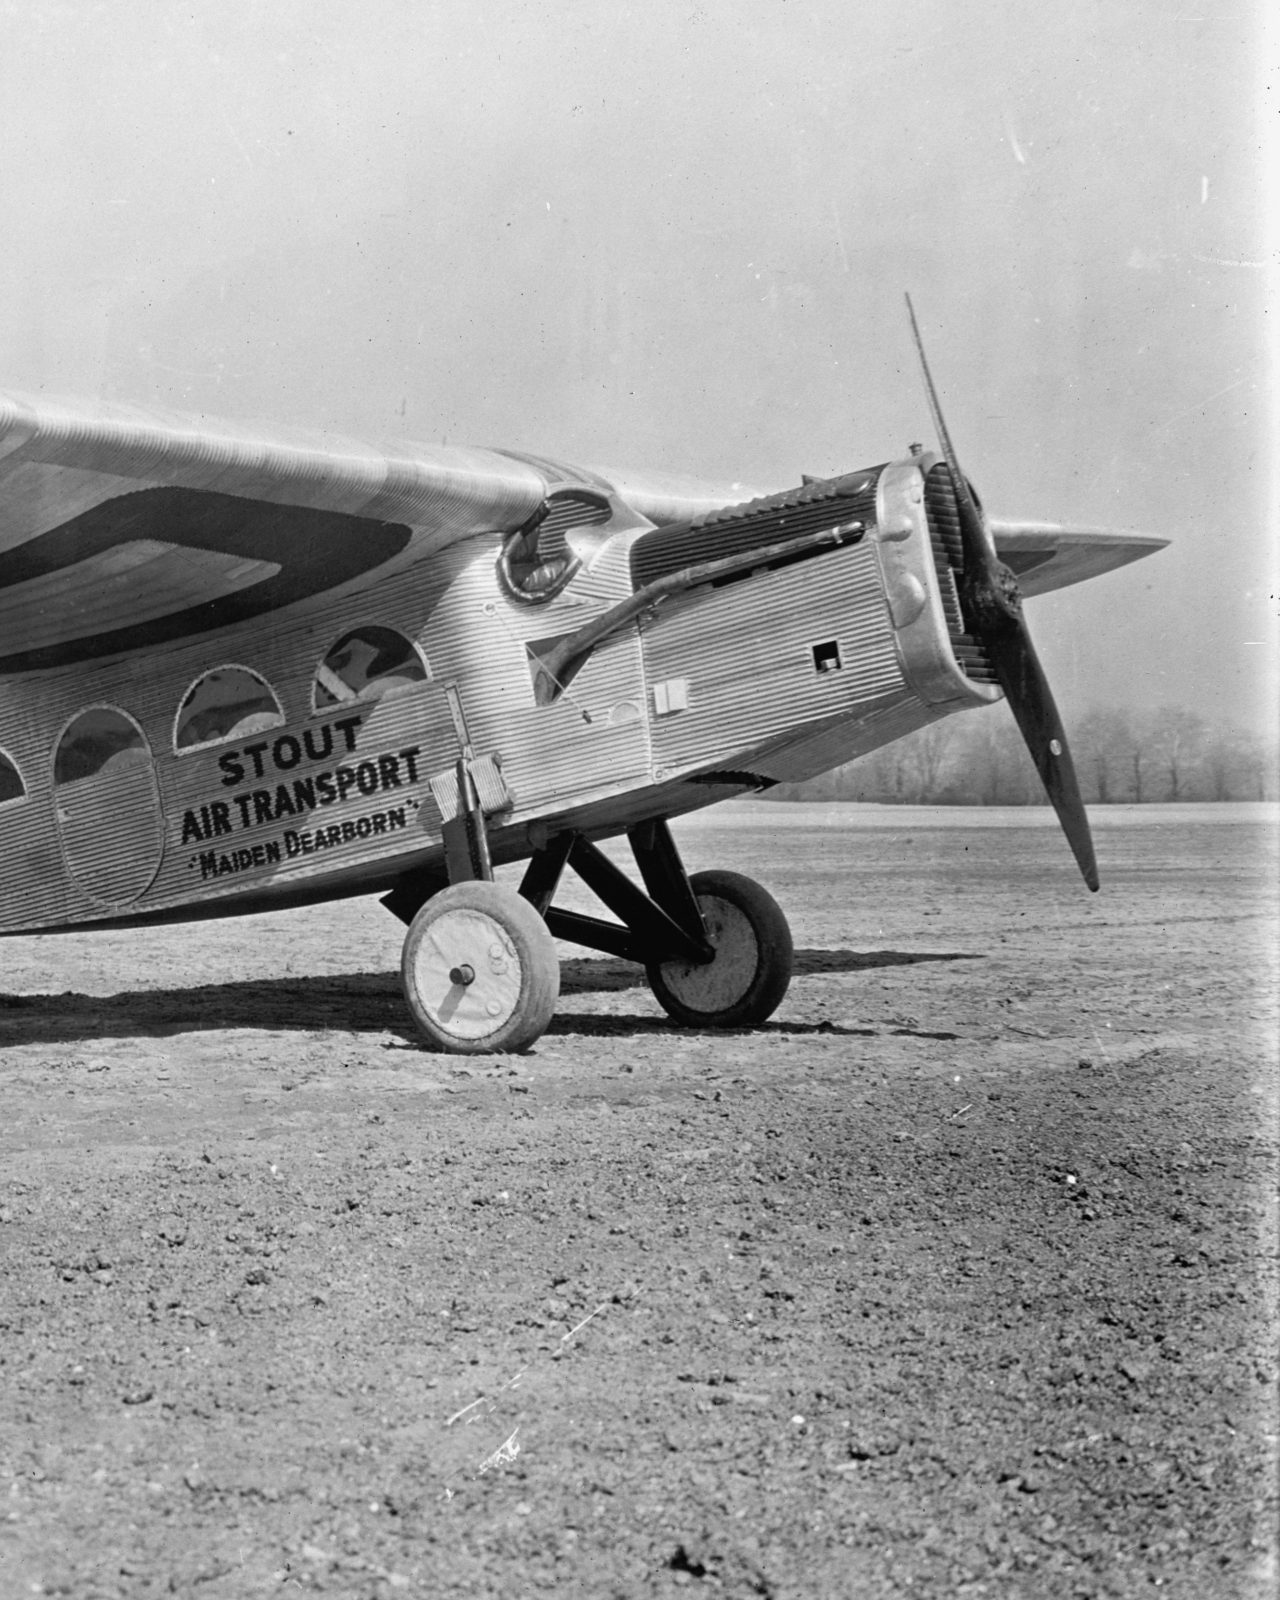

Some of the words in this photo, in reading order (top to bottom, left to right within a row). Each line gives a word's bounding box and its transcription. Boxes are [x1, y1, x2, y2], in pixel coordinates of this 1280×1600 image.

[219, 715, 362, 787] STOUT
[182, 801, 232, 845] AIR
[233, 746, 420, 829] TRANSPORT
